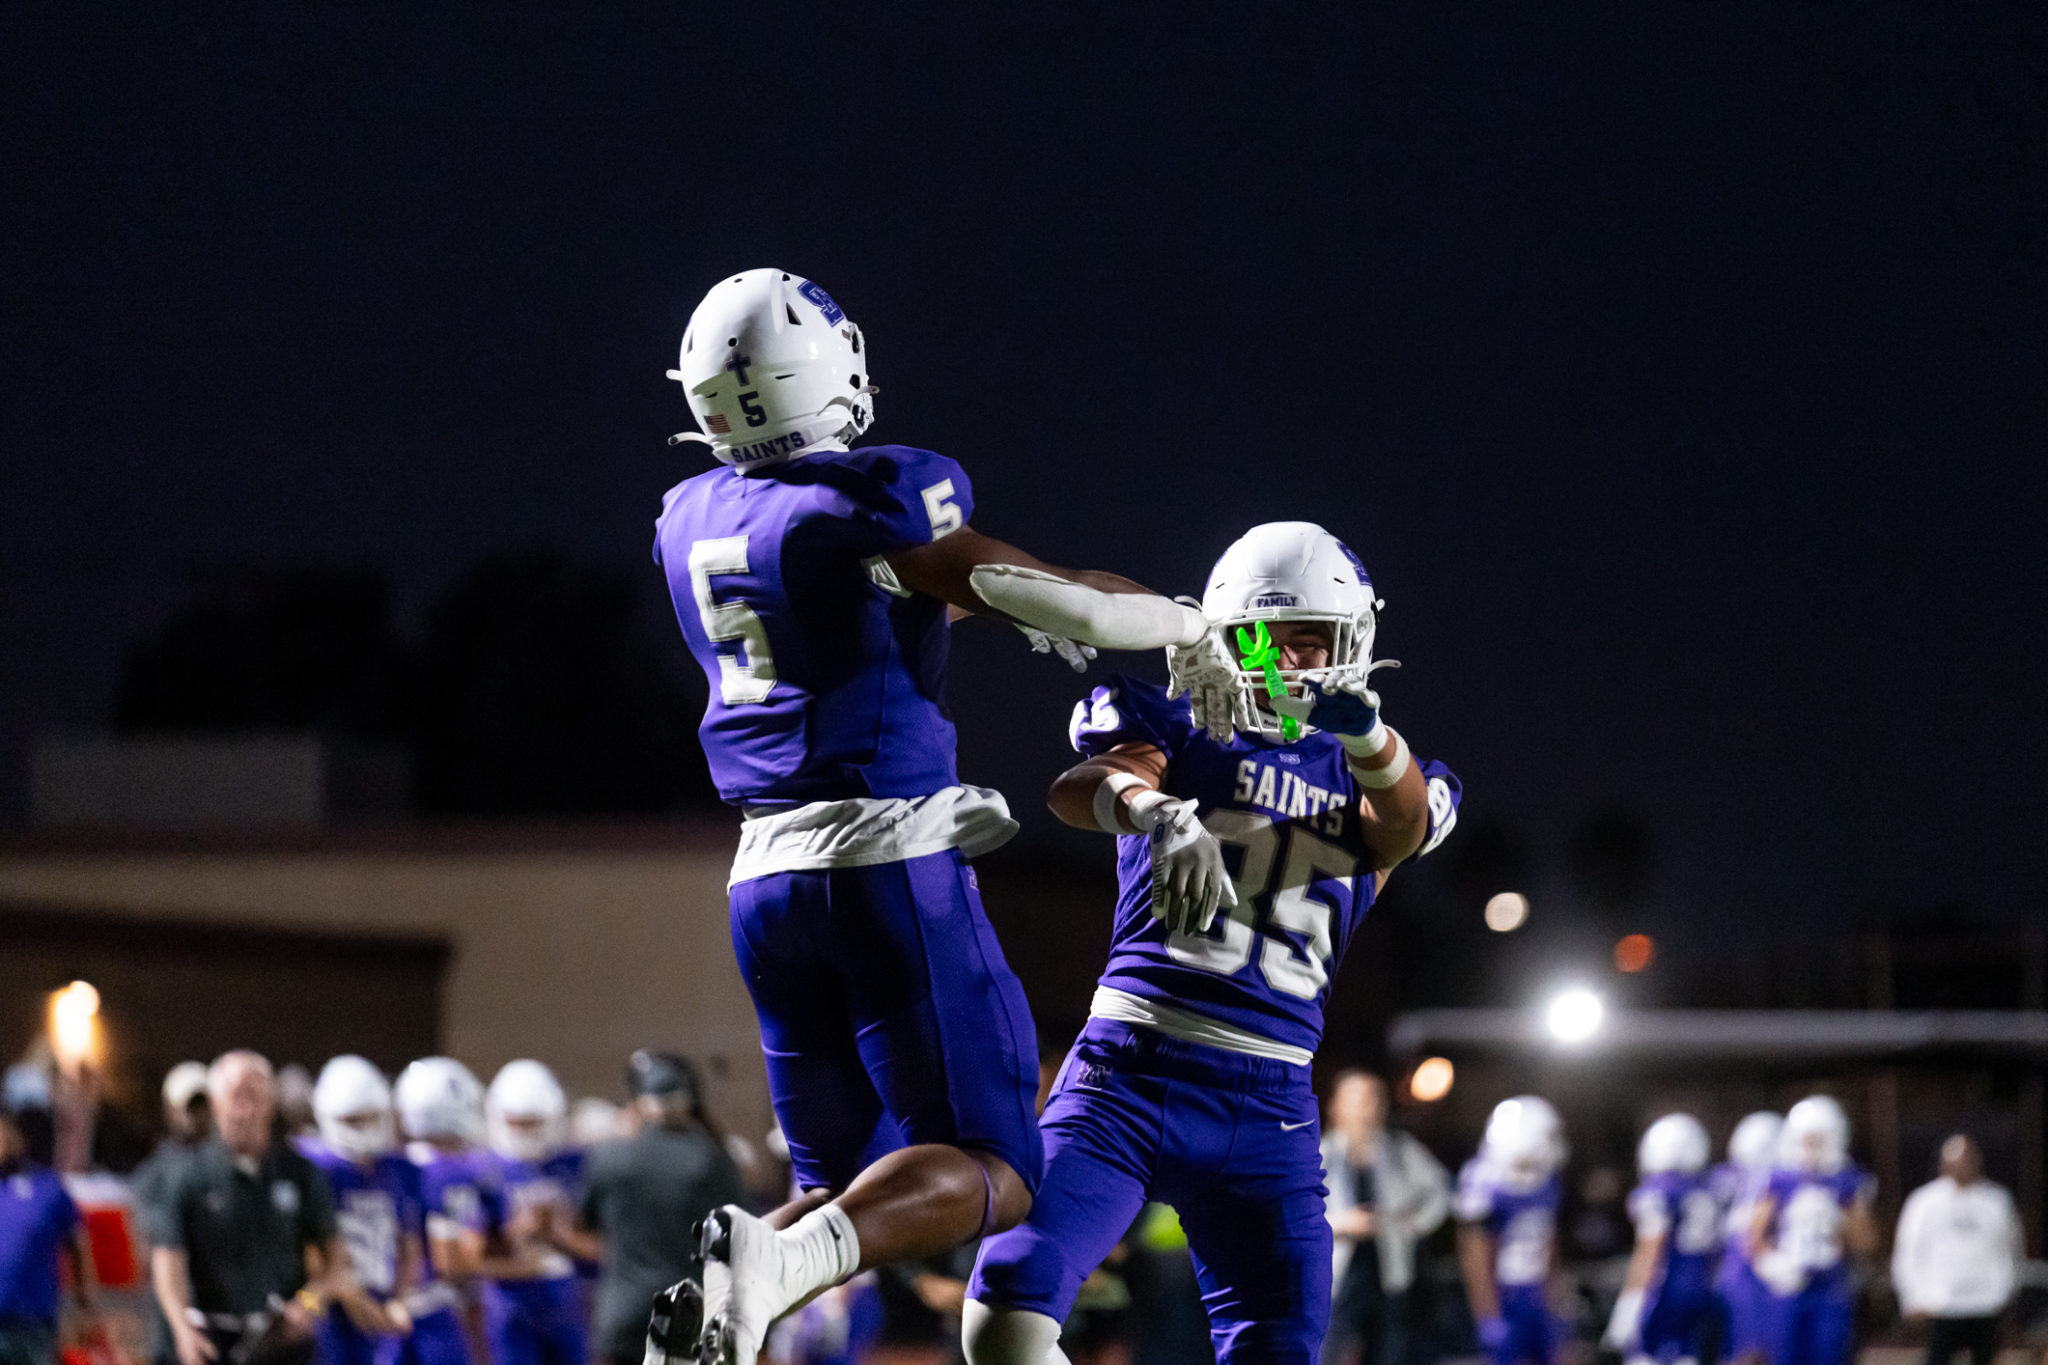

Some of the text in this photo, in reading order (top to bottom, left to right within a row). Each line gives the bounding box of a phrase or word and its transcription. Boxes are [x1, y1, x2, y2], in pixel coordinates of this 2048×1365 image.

[737, 391, 768, 428] 5
[730, 431, 806, 463] SAINTS
[920, 478, 963, 543] 5
[688, 534, 778, 705] 5
[1256, 596, 1298, 608] FAMILY
[1233, 759, 1348, 837] SAINTS
[1164, 807, 1360, 1001] 85
